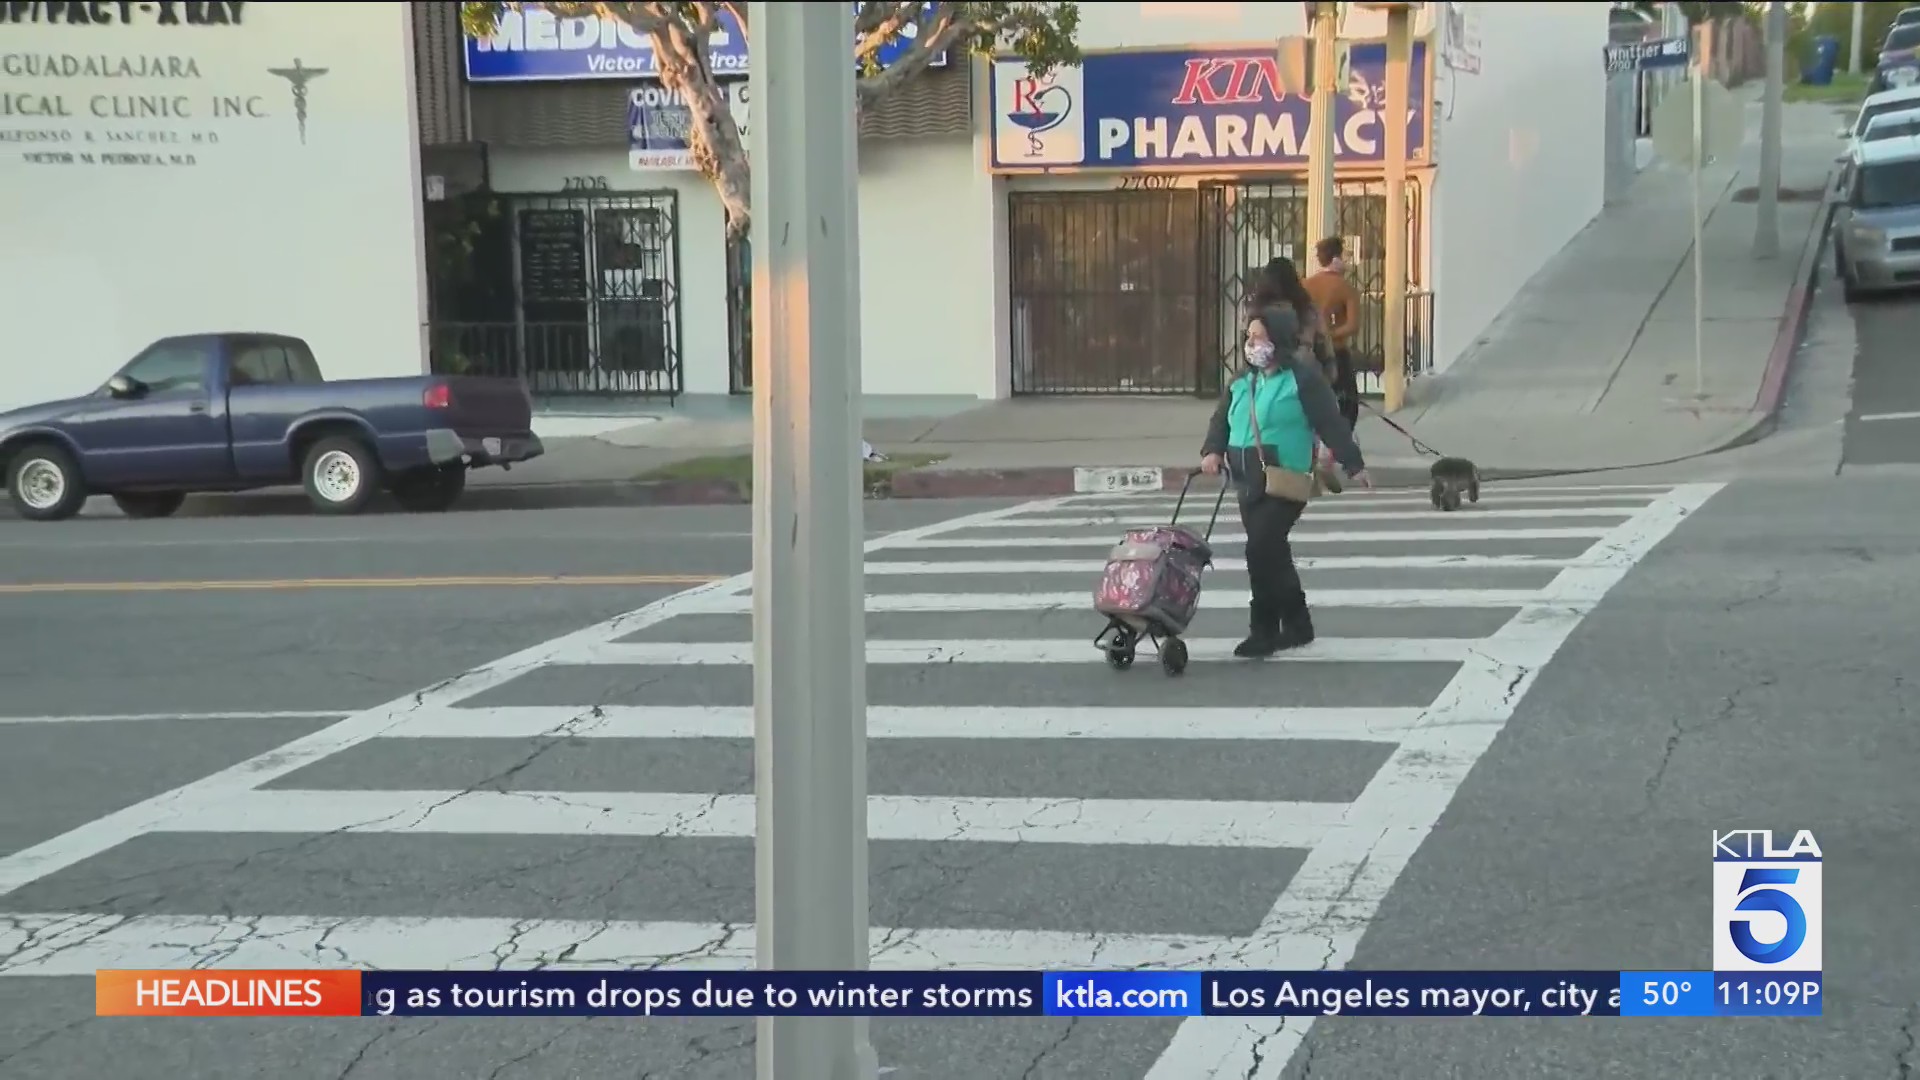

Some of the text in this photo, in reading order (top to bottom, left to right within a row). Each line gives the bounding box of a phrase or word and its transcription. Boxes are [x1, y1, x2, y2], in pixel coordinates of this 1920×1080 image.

[478, 8, 729, 52] MEDIC
[1607, 42, 1660, 60] Whittier
[3, 54, 201, 78] GUADALAJARA
[587, 53, 645, 72] Victor
[1172, 57, 1311, 104] KIN
[90, 96, 190, 118] CLINIC
[23, 151, 74, 165] VICTOR
